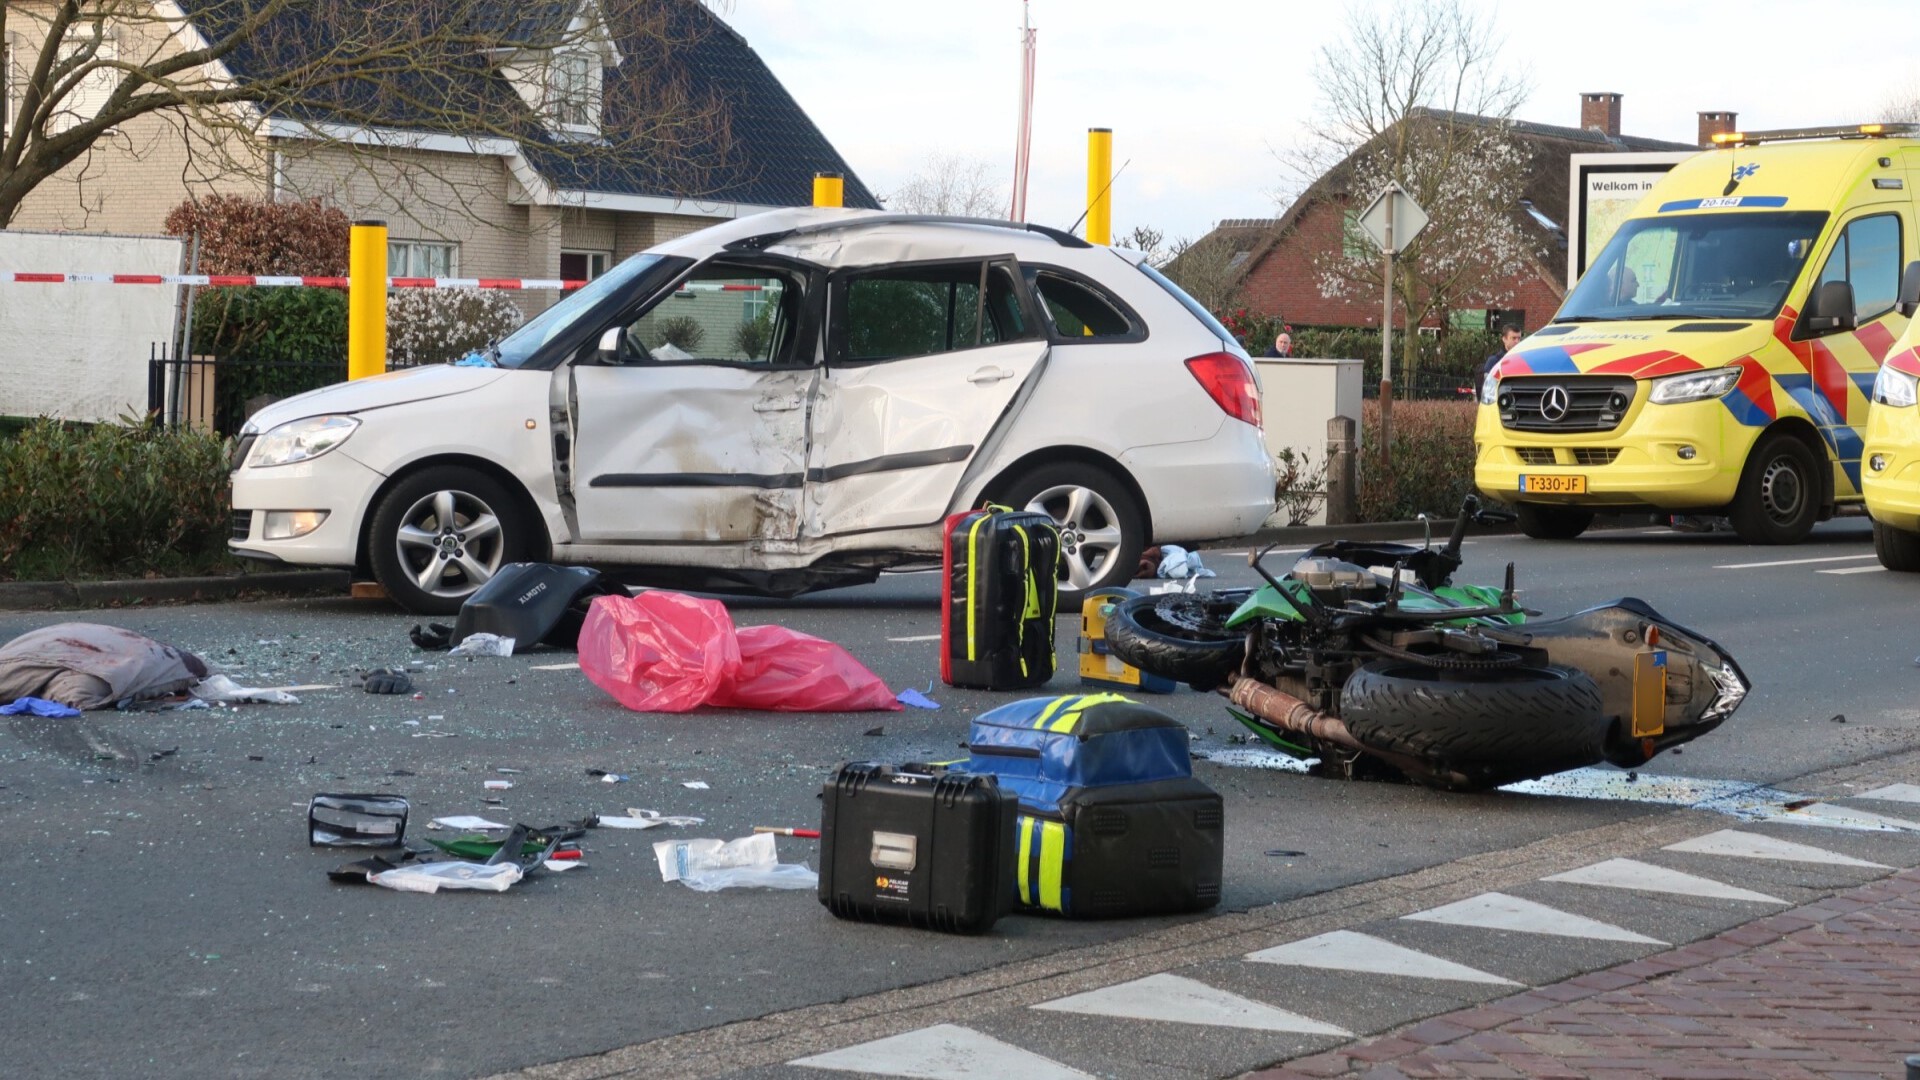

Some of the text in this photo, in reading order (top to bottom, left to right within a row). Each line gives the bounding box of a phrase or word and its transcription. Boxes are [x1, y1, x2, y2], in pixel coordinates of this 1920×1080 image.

[1592, 181, 1652, 191] Welkom in
[1702, 198, 1737, 207] 20-164
[1556, 333, 1651, 341] AMBULANCE
[1530, 477, 1578, 491] T-330-JF
[518, 582, 547, 604] XLMOTO
